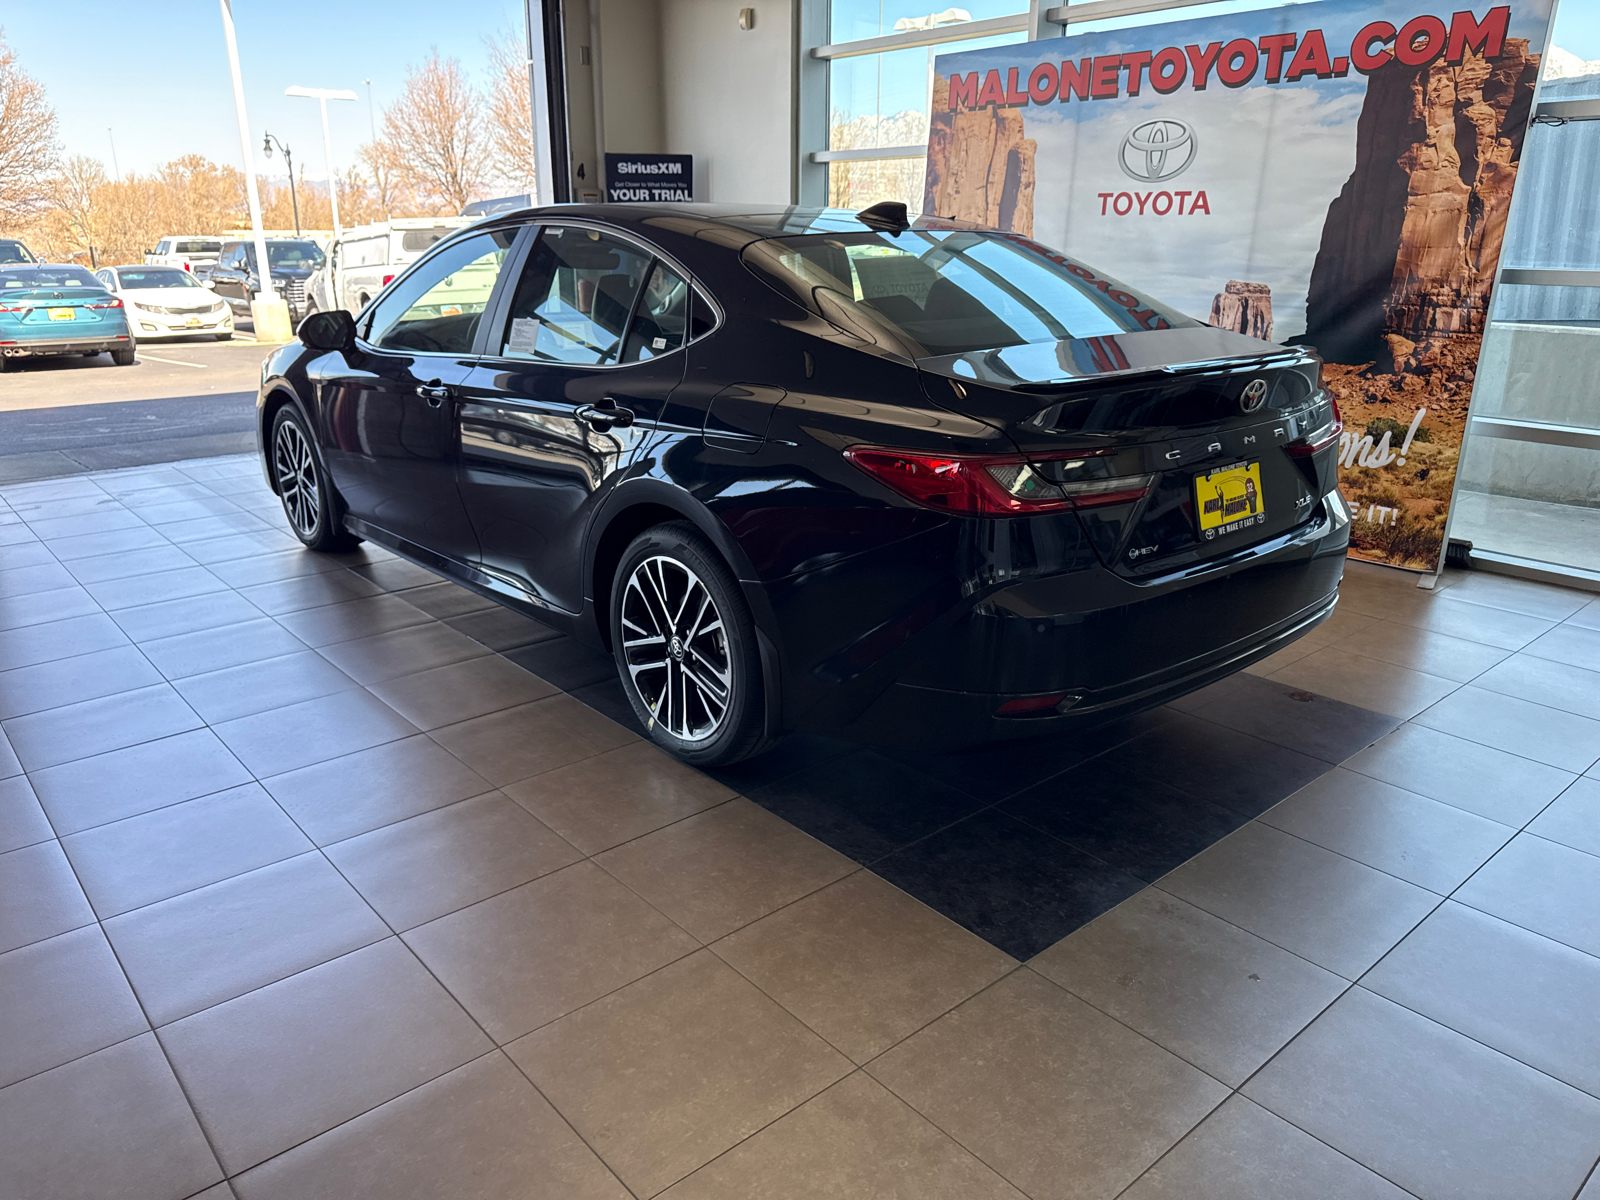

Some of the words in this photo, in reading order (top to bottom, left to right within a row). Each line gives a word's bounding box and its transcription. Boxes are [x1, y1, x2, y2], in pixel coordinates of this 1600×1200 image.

[949, 6, 1511, 109] MALONETOYOTA.COM
[577, 163, 585, 180] 4
[617, 162, 682, 174] SiriusXM
[610, 190, 649, 201] YOUR
[652, 190, 692, 202] TRIAL
[1098, 191, 1211, 216] TOYOTA
[889, 283, 929, 293] TOYOTA
[1165, 420, 1308, 460] CAMRY
[1247, 483, 1254, 492] 32
[1204, 498, 1220, 515] KARL
[1225, 498, 1247, 517] MALONE
[1294, 495, 1311, 509] XLE
[1367, 505, 1398, 526] IT!
[1218, 527, 1226, 535] WE
[1226, 523, 1239, 532] MAKE
[1244, 518, 1255, 526] EASY
